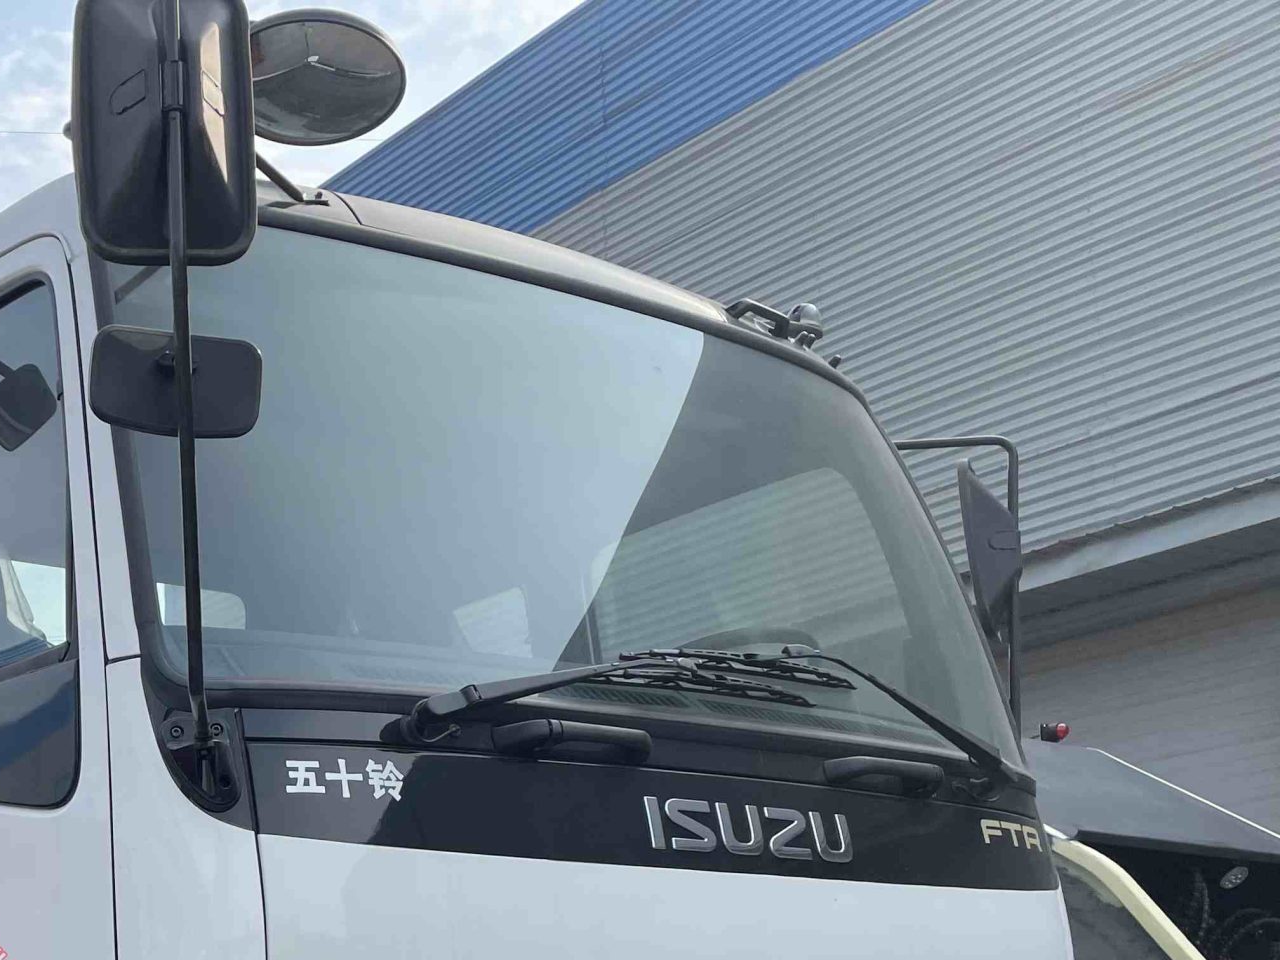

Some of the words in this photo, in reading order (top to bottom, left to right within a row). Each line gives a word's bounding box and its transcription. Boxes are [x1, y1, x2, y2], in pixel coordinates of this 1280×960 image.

[285, 758, 405, 802] 五十铃
[642, 795, 854, 864] ISUZU
[980, 818, 1043, 853] FTR
